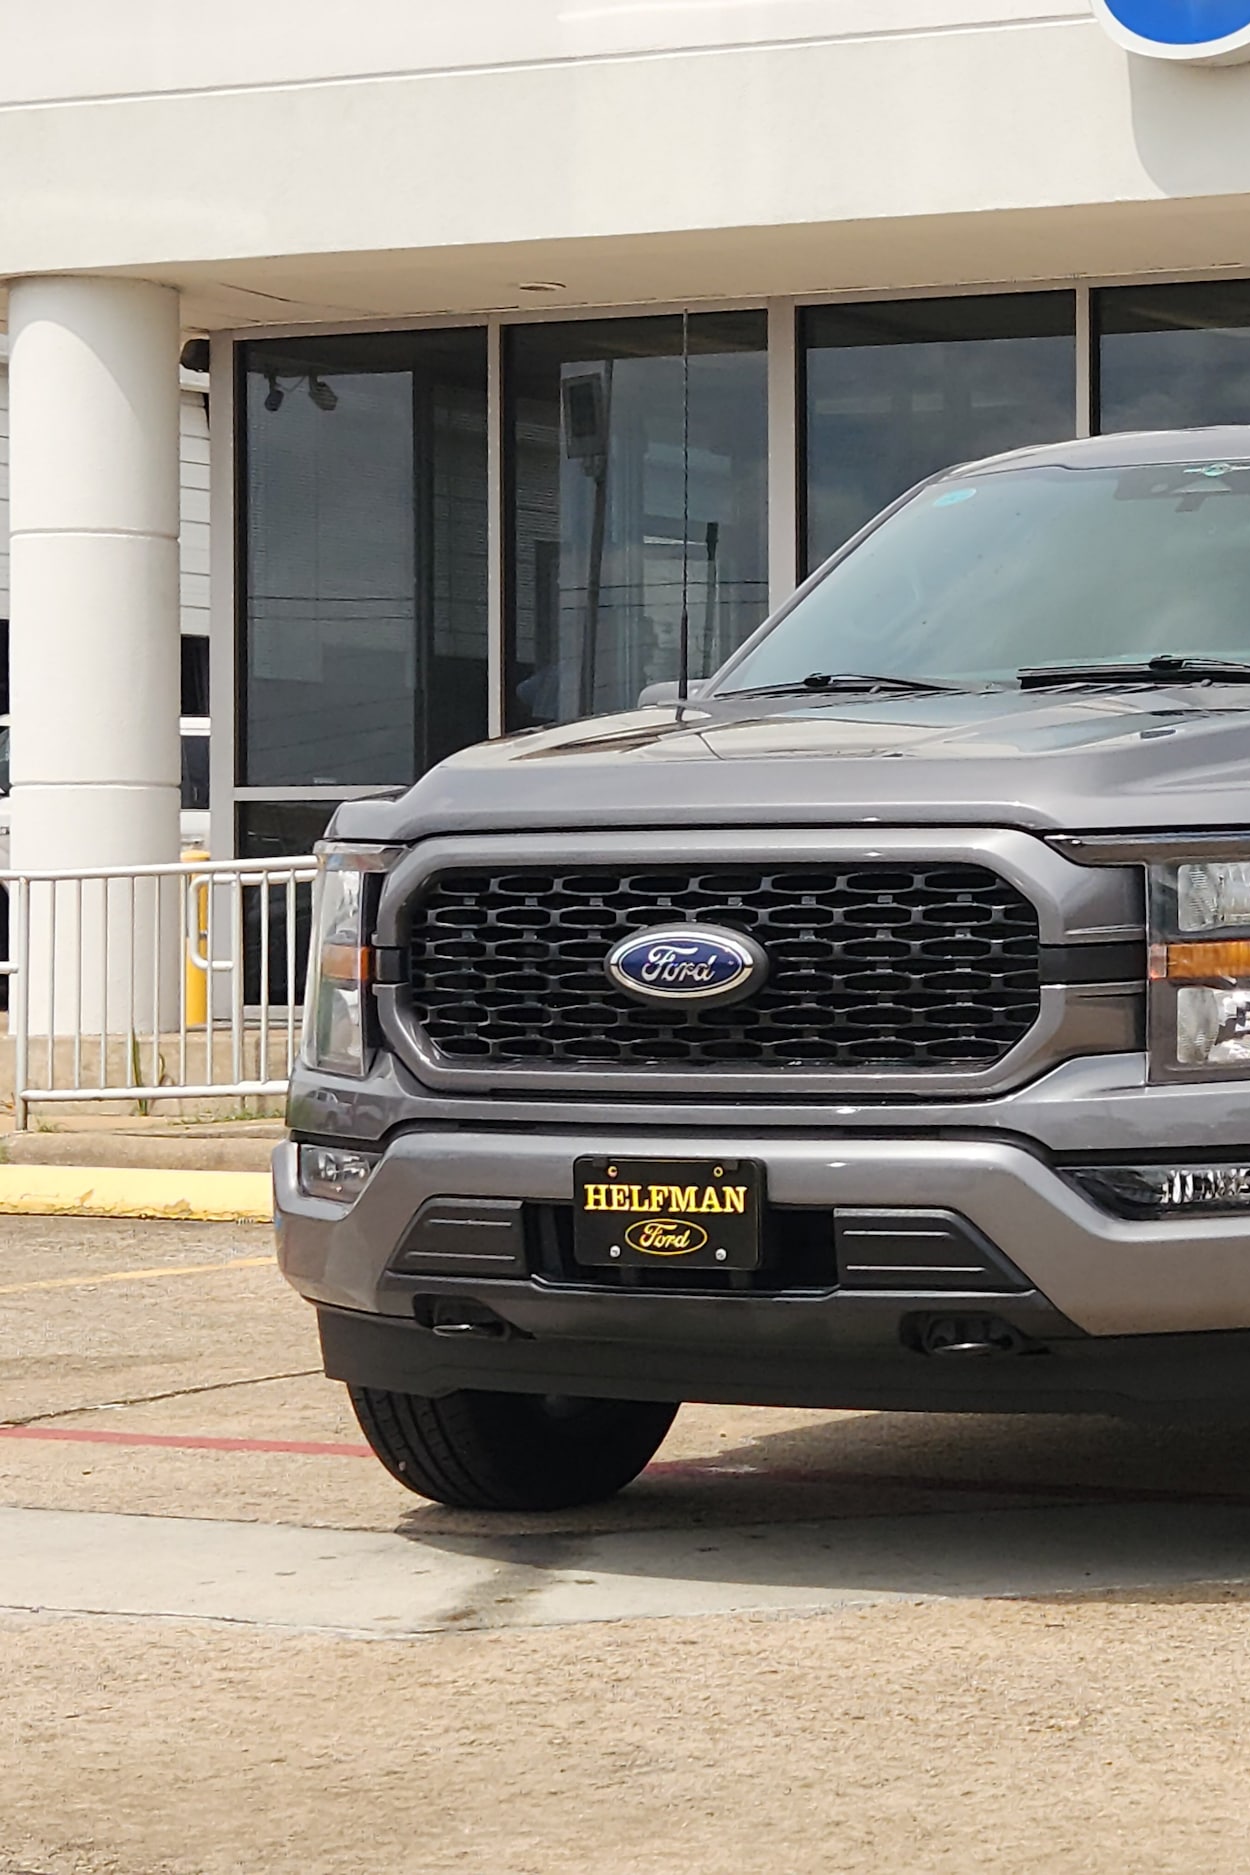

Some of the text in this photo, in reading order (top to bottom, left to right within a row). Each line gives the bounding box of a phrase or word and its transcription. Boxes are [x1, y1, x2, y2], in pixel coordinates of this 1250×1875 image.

[641, 945, 718, 981] Ford
[583, 1184, 748, 1213] HELFMAN
[639, 1222, 691, 1248] Ford
